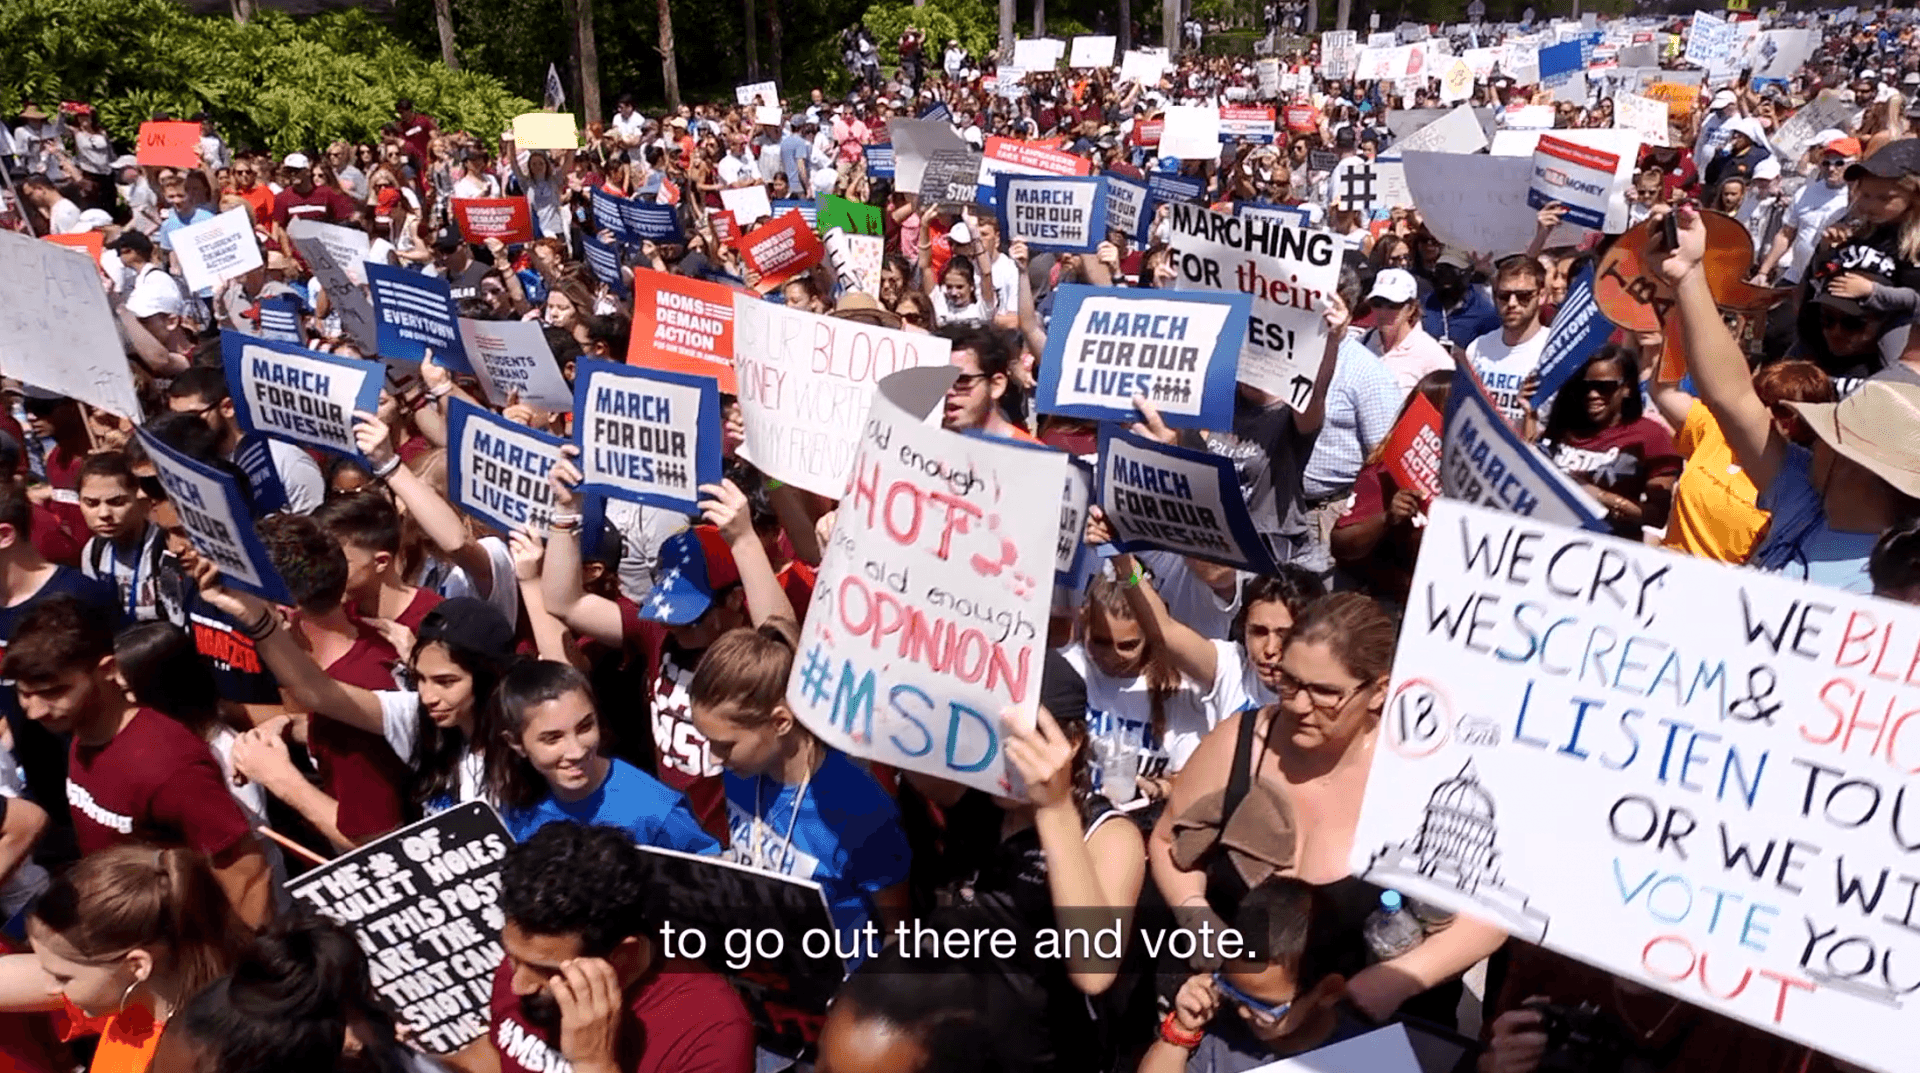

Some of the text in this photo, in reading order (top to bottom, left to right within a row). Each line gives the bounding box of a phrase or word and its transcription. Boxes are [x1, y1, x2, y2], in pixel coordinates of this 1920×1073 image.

[1015, 188, 1074, 206] MARCH
[1016, 206, 1083, 224] FOR OUR
[1017, 224, 1059, 239] LIVES
[1172, 203, 1334, 267] MARCHING
[656, 290, 705, 315] MOMS
[1235, 259, 1321, 312] their
[382, 308, 456, 340] EVERYTOWN
[654, 326, 715, 351] ACTION
[656, 307, 724, 336] DEMAND
[1086, 310, 1190, 341] MARCH
[1248, 315, 1296, 360] ES!
[252, 358, 330, 397] MARCH
[483, 353, 537, 368] STUDENTS
[486, 366, 530, 381] DEMAND
[1079, 339, 1199, 372] FOR OUR
[255, 384, 344, 425] FOR OUR
[595, 387, 672, 424] MARCH
[736, 353, 871, 428] MONEY WORTH
[1073, 368, 1153, 398] LIVES
[1290, 374, 1314, 408] 17
[259, 405, 320, 438] LIVES
[594, 418, 688, 459] FOR OUR
[473, 430, 556, 478] MARCH
[595, 450, 655, 483] LIVES
[900, 444, 985, 496] enough
[1458, 417, 1538, 517] MARCH
[472, 454, 556, 506] FOR OU
[1113, 454, 1193, 501] MARCH
[181, 501, 236, 547] OUR
[471, 480, 529, 524] LIVES
[847, 452, 983, 561] HOT
[1113, 487, 1221, 531] FOR OUR
[1119, 515, 1194, 547] LIVES
[864, 559, 910, 594] old
[927, 587, 1036, 643] enough
[1459, 515, 1545, 587] WE
[1738, 585, 1836, 656] WE
[839, 575, 1032, 704] OPINION
[1427, 581, 1501, 654] WE
[1494, 601, 1728, 722] SCREAM
[1726, 663, 1784, 727] &
[800, 642, 998, 773] #MSD
[1511, 677, 1771, 812] LISTEN
[291, 827, 443, 907] THE # OF
[422, 834, 506, 887] HOLES
[1607, 793, 1920, 935] OR WE WI
[367, 897, 446, 946] THIS
[1611, 856, 1781, 955] VOTE
[367, 942, 429, 988] ARE
[418, 916, 485, 957] THE
[378, 940, 506, 1008] THAT CAN
[1641, 932, 1818, 1025] OUT
[402, 984, 473, 1032] SHOT
[418, 1011, 491, 1053] TIME
